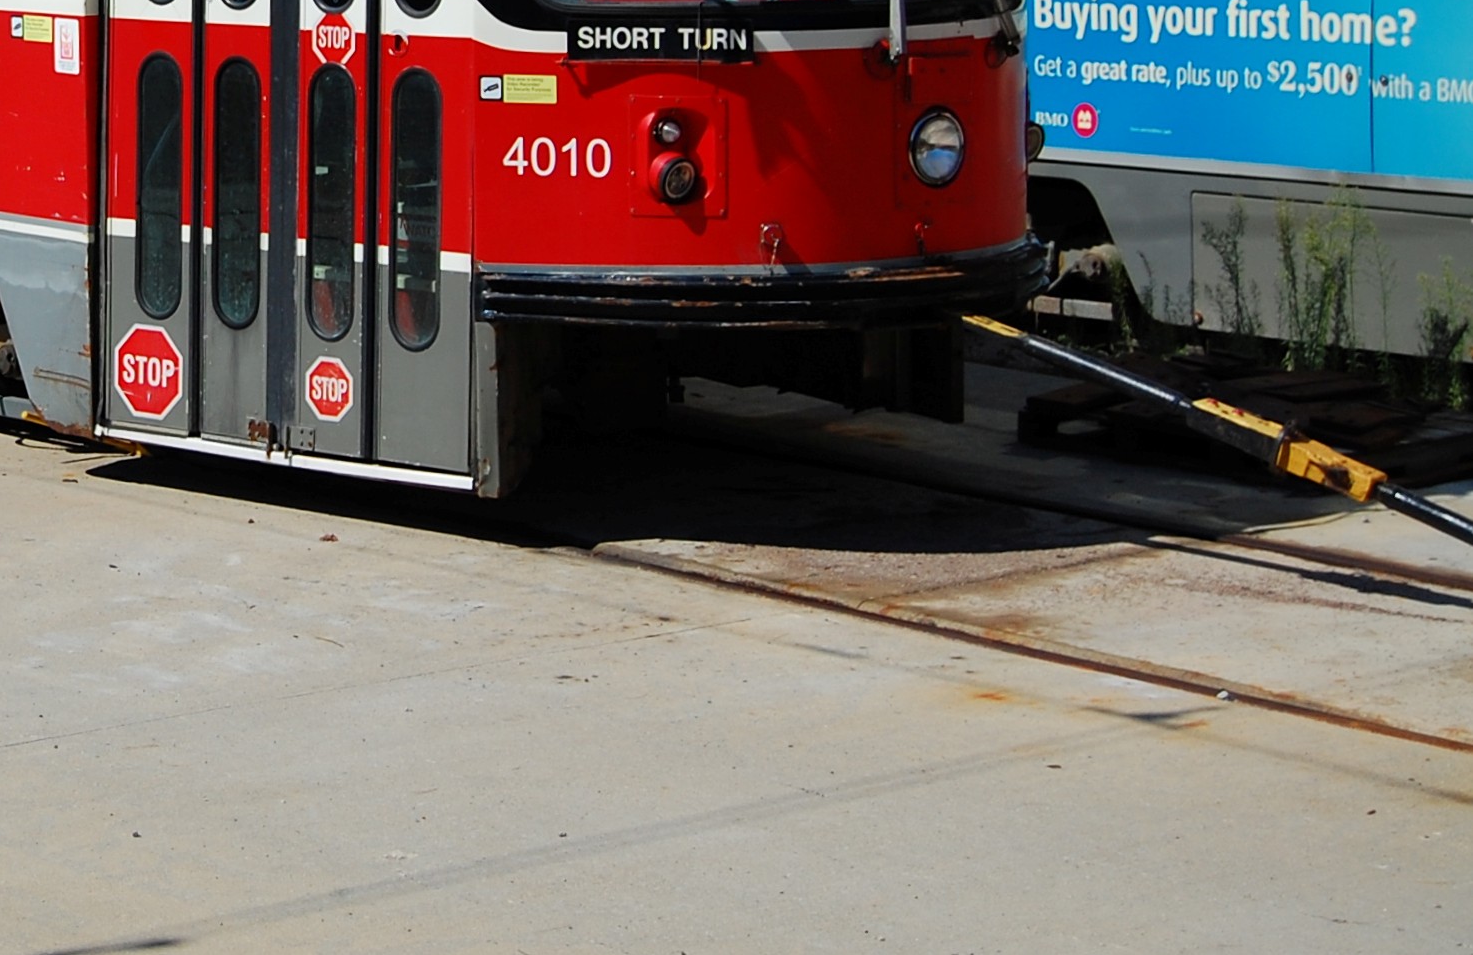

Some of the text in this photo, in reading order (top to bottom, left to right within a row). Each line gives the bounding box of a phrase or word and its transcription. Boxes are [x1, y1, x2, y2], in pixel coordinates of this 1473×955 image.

[318, 25, 350, 49] STOP
[577, 26, 747, 51] SHORT TURN
[1147, 5, 1218, 44] your
[1300, 0, 1417, 47] home?
[1034, 55, 1062, 78] Get
[1066, 60, 1077, 79] a
[1081, 60, 1127, 85] great
[1131, 62, 1171, 88] rate,
[1177, 61, 1211, 90] plus
[1216, 74, 1239, 94] up
[1244, 67, 1262, 90] to
[1369, 73, 1414, 100] with
[1419, 81, 1432, 102] a
[1035, 111, 1069, 128] BMO
[502, 136, 612, 178] 4010
[122, 353, 175, 389] STOP
[311, 374, 348, 403] STOP
